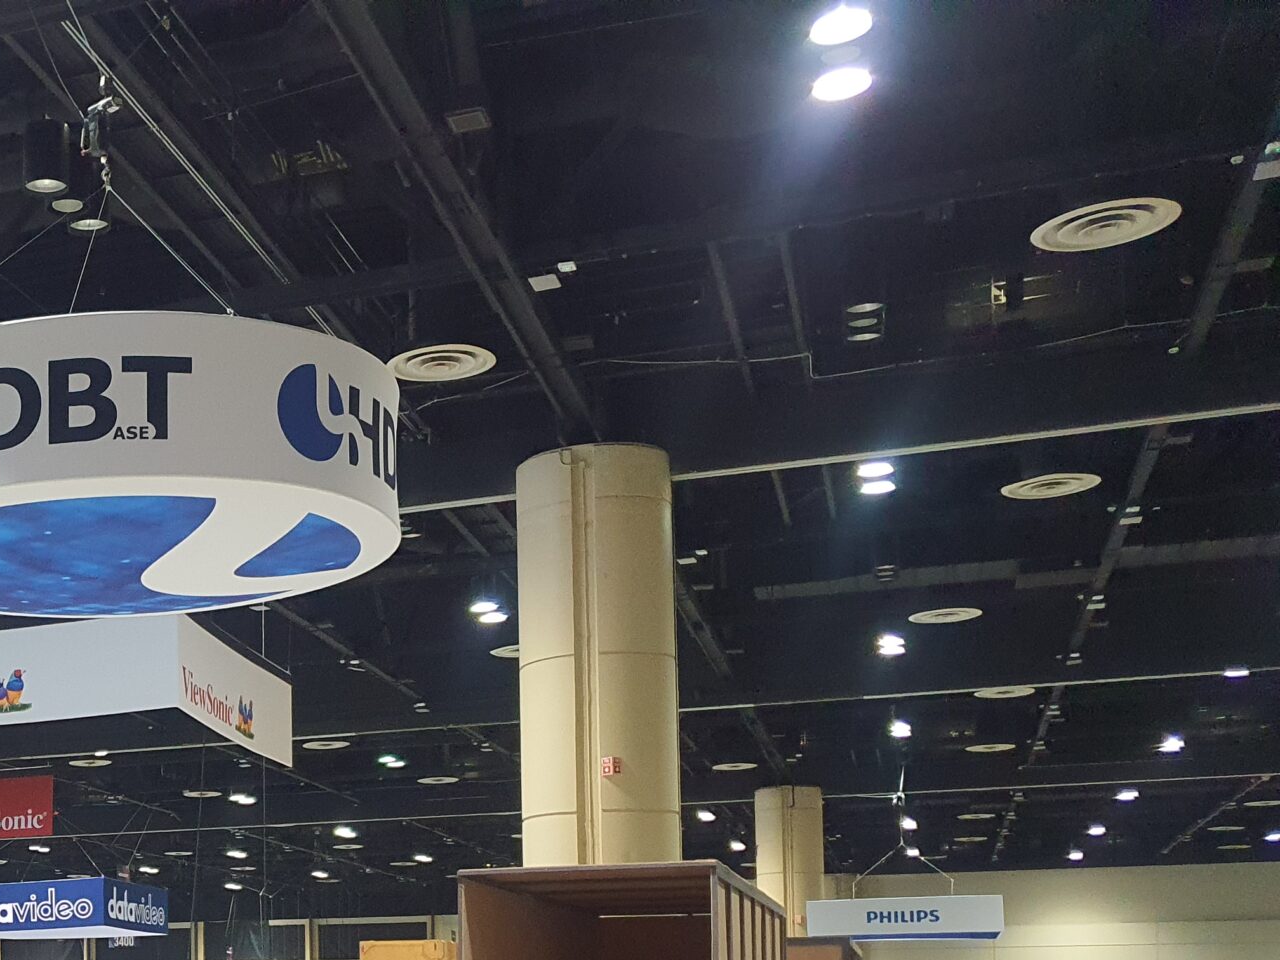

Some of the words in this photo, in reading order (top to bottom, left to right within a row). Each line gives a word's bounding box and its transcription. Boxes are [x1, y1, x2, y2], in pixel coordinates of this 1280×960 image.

[183, 665, 233, 727] ViewSonic
[108, 886, 165, 926] datavideo
[866, 909, 940, 924] PHILIPS
